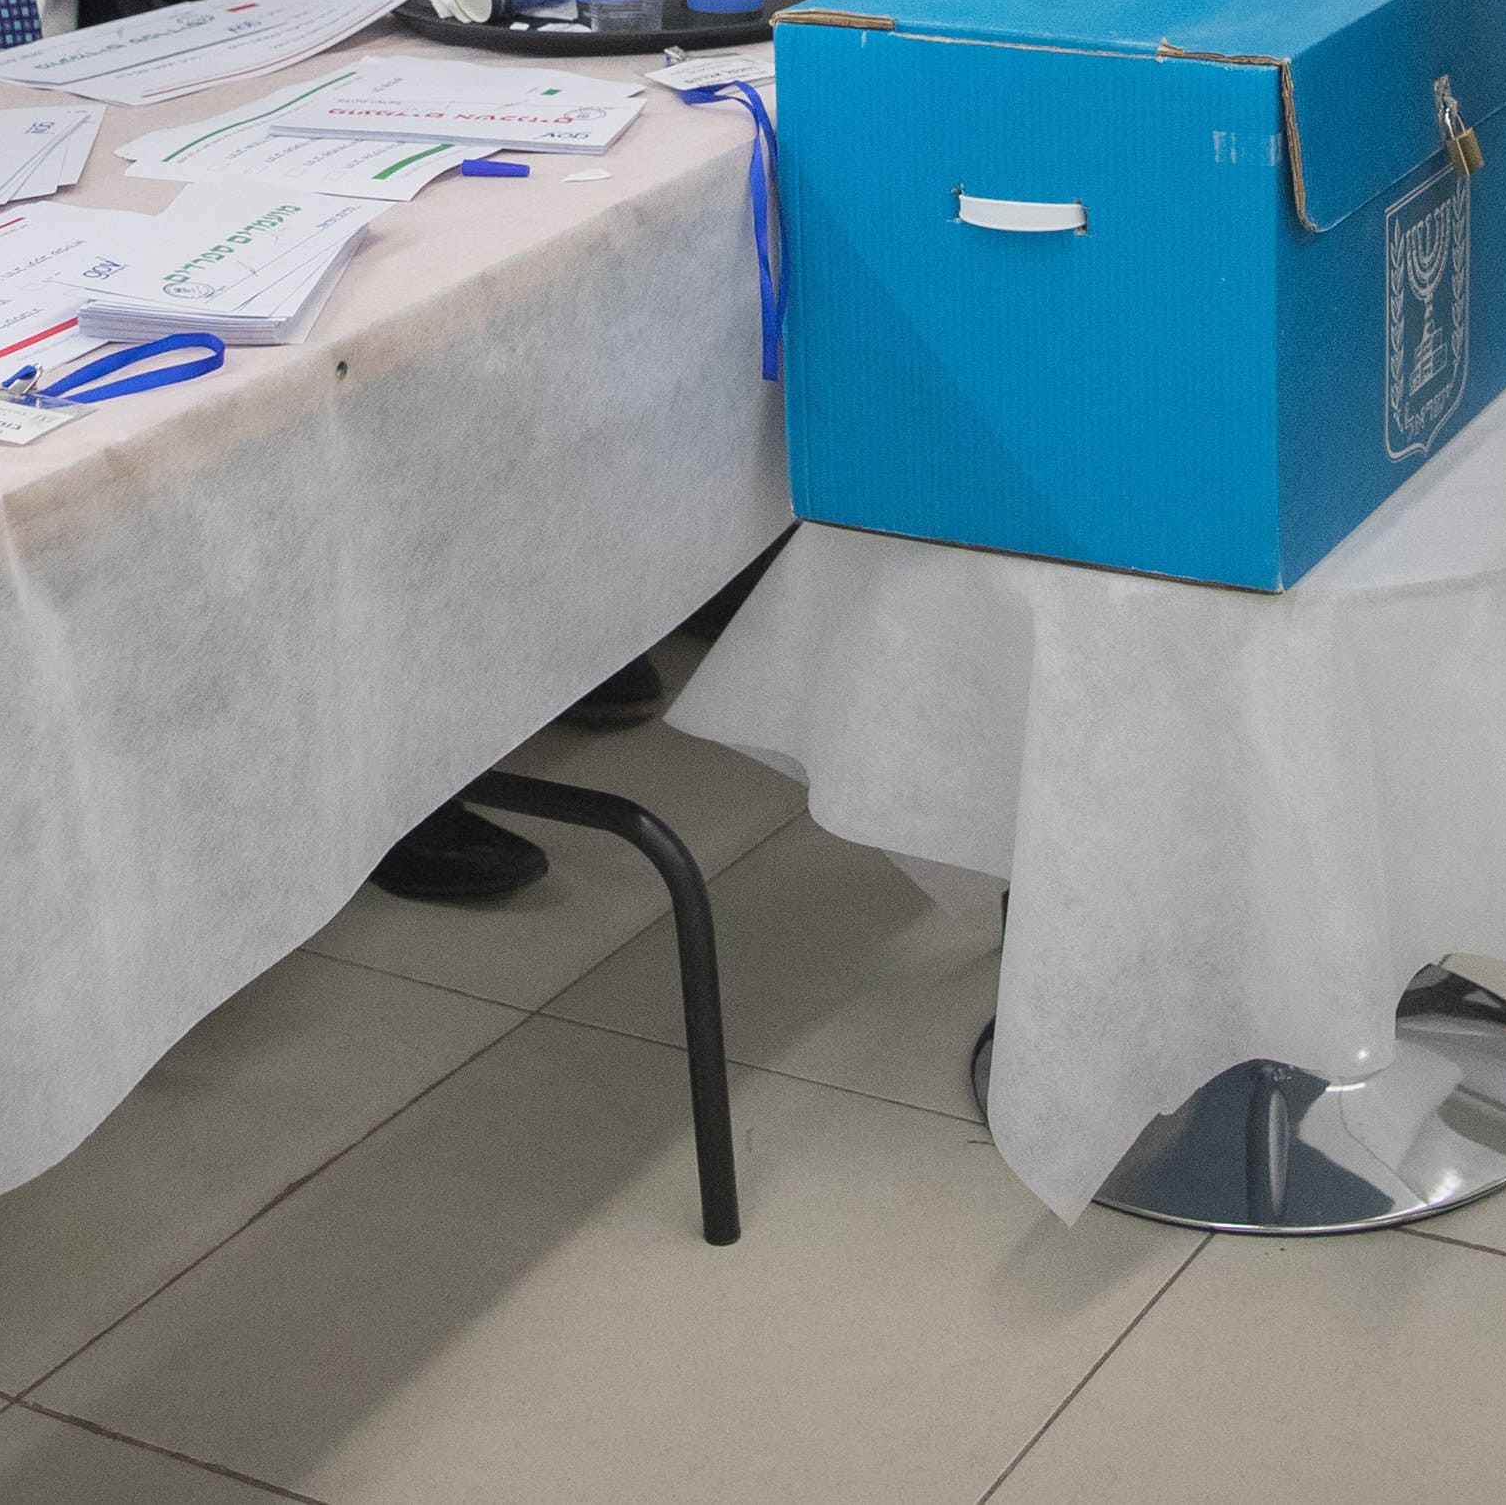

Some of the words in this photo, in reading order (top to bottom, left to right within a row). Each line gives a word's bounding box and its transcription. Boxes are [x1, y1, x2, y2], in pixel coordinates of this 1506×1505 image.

[327, 107, 446, 120] מועמדים
[453, 111, 575, 125] אשכנזים
[224, 203, 303, 246] מועמדים
[82, 257, 122, 281] gov
[163, 243, 235, 285] ספרדים
